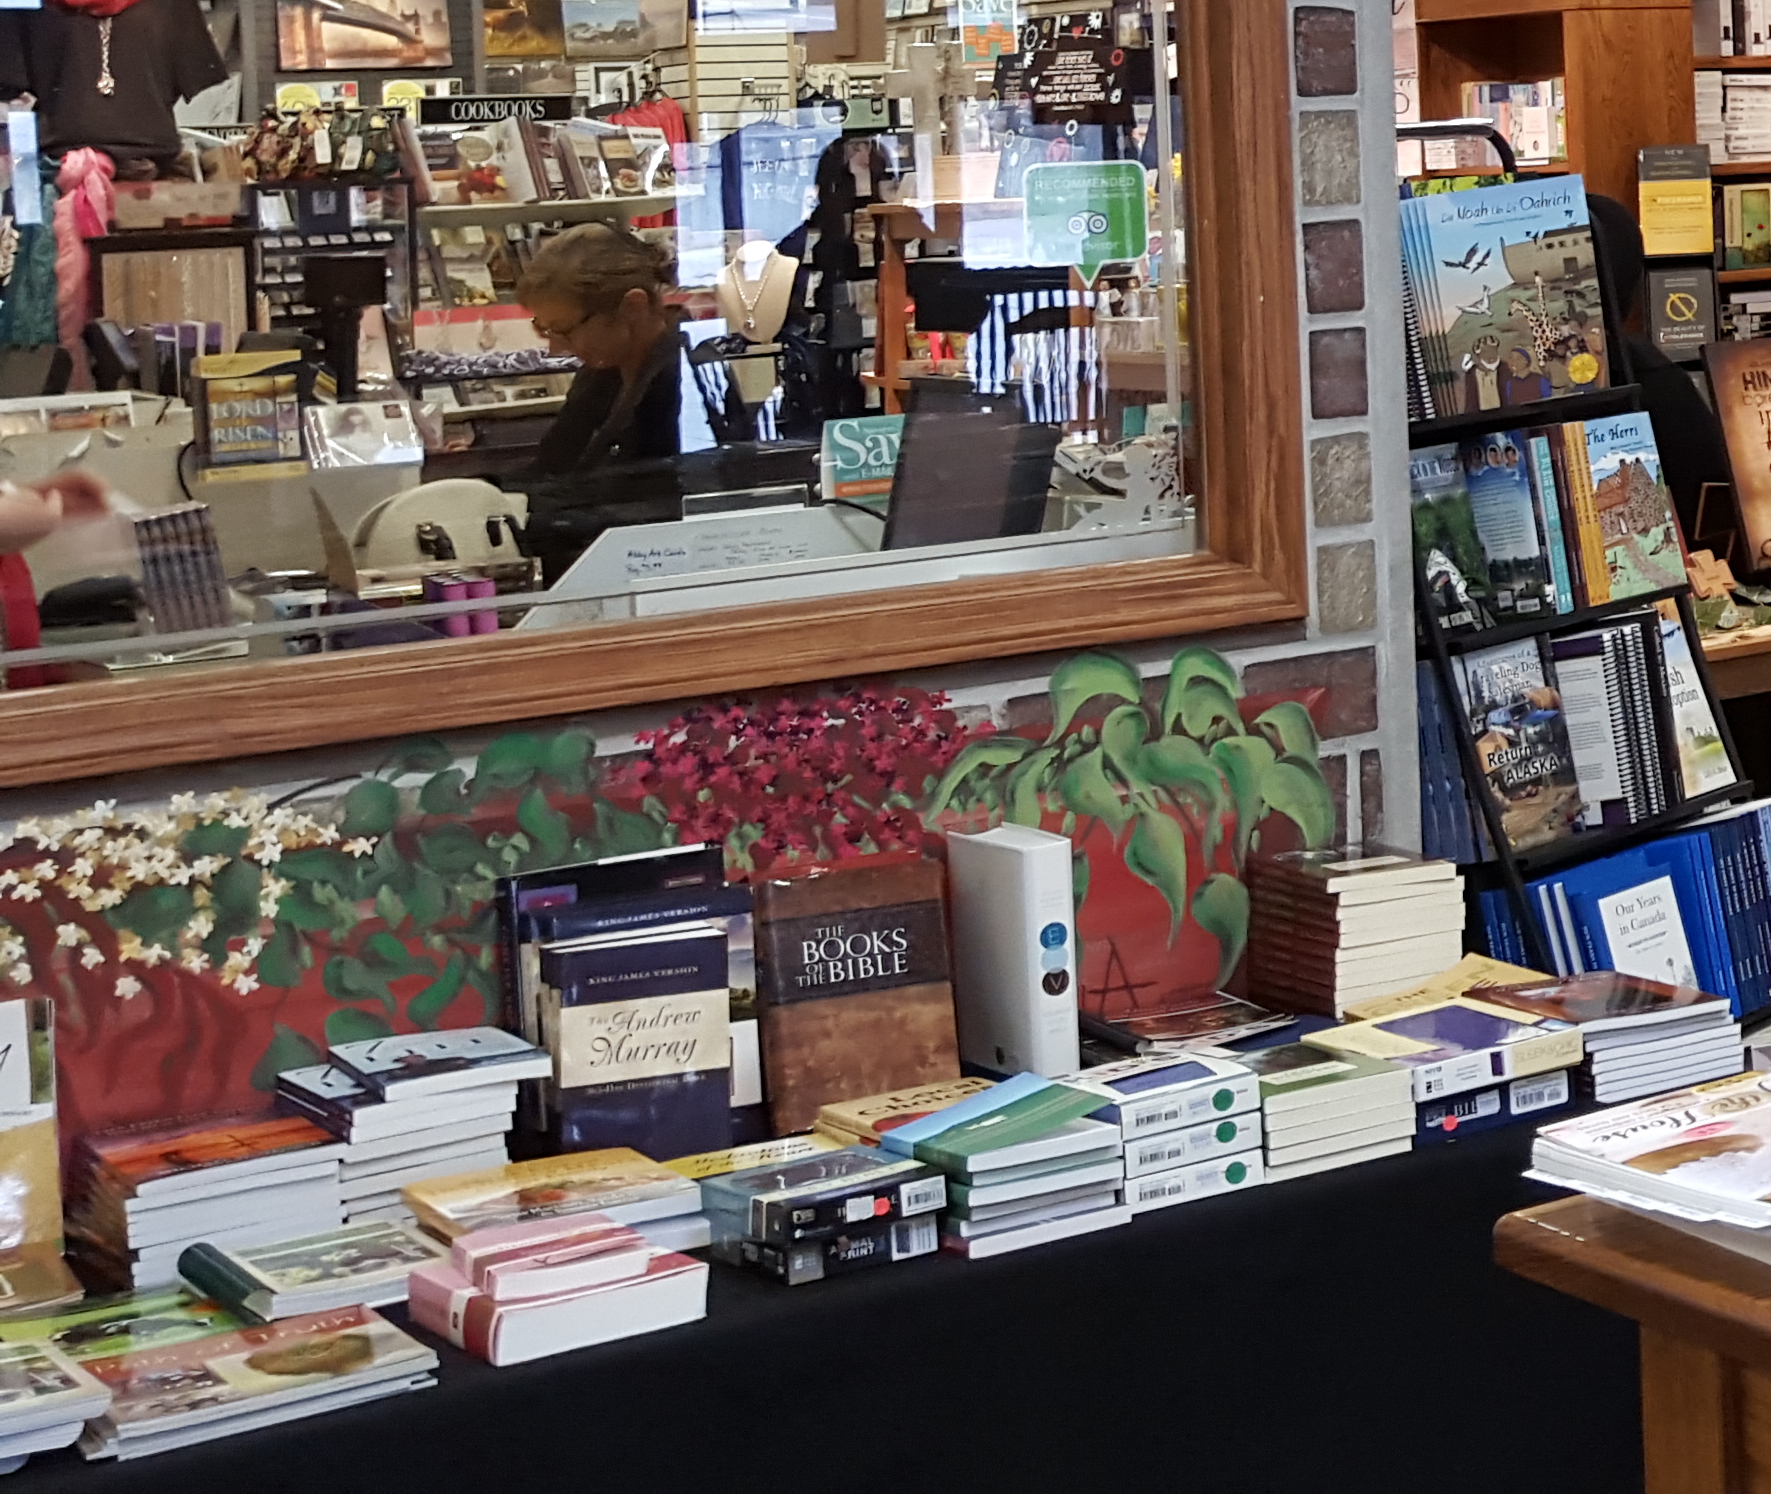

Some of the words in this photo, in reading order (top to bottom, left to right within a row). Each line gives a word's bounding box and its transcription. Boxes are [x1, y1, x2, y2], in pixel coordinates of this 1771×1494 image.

[450, 98, 548, 122] COOKBOOKS
[1457, 200, 1489, 220] Noah
[1486, 745, 1534, 768] Return
[1505, 754, 1561, 786] ALASKA
[663, 905, 709, 920] VERSION
[1615, 901, 1636, 918] Our
[1637, 892, 1663, 910] Years
[816, 925, 846, 939] THE
[1630, 909, 1668, 932] Canada
[801, 927, 909, 966] BOOKS
[619, 970, 651, 984] JAMES
[652, 965, 700, 981] VERSION
[795, 973, 827, 989] THE
[828, 952, 910, 985] BIBLE
[606, 1003, 703, 1037] Andrew
[588, 1030, 699, 1069] Murray
[889, 1077, 991, 1106] Local
[1592, 1109, 1700, 1145] House
